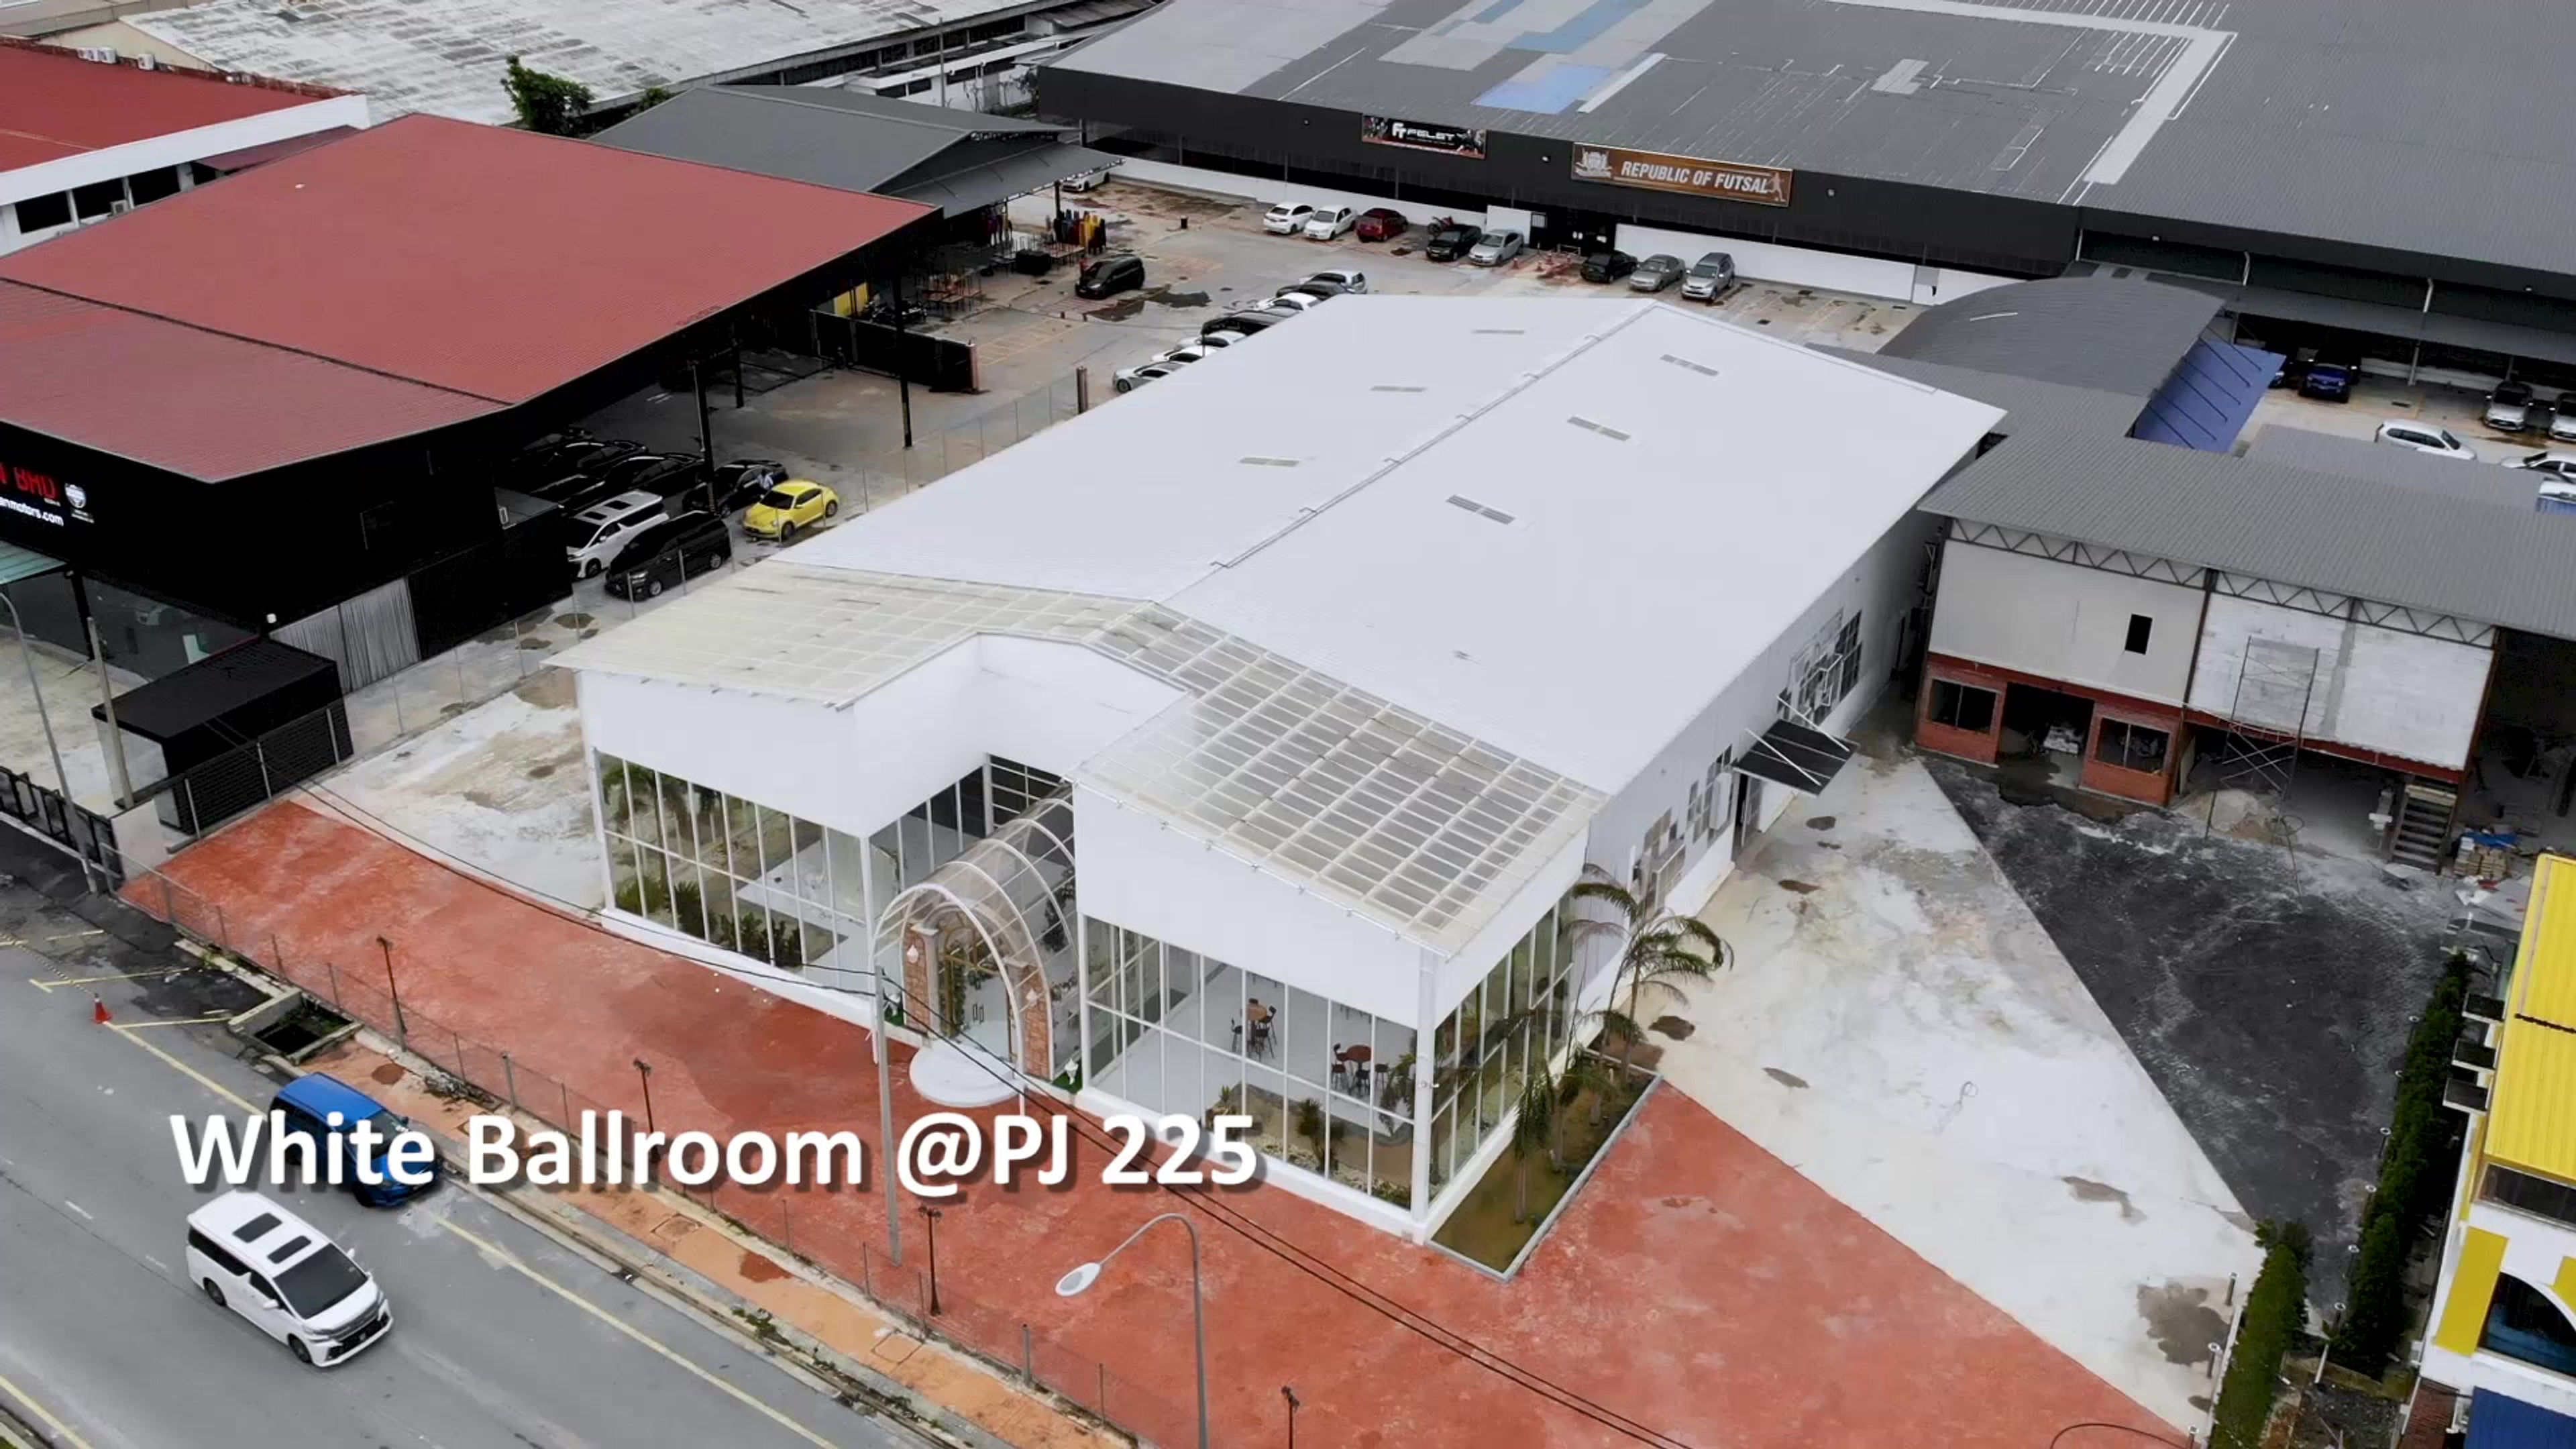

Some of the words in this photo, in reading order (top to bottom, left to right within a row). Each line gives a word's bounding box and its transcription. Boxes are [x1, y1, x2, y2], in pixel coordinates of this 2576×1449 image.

[1621, 161, 1690, 183] REPUBLIC
[1693, 170, 1713, 186] OF
[1715, 173, 1769, 194] FUTSAL
